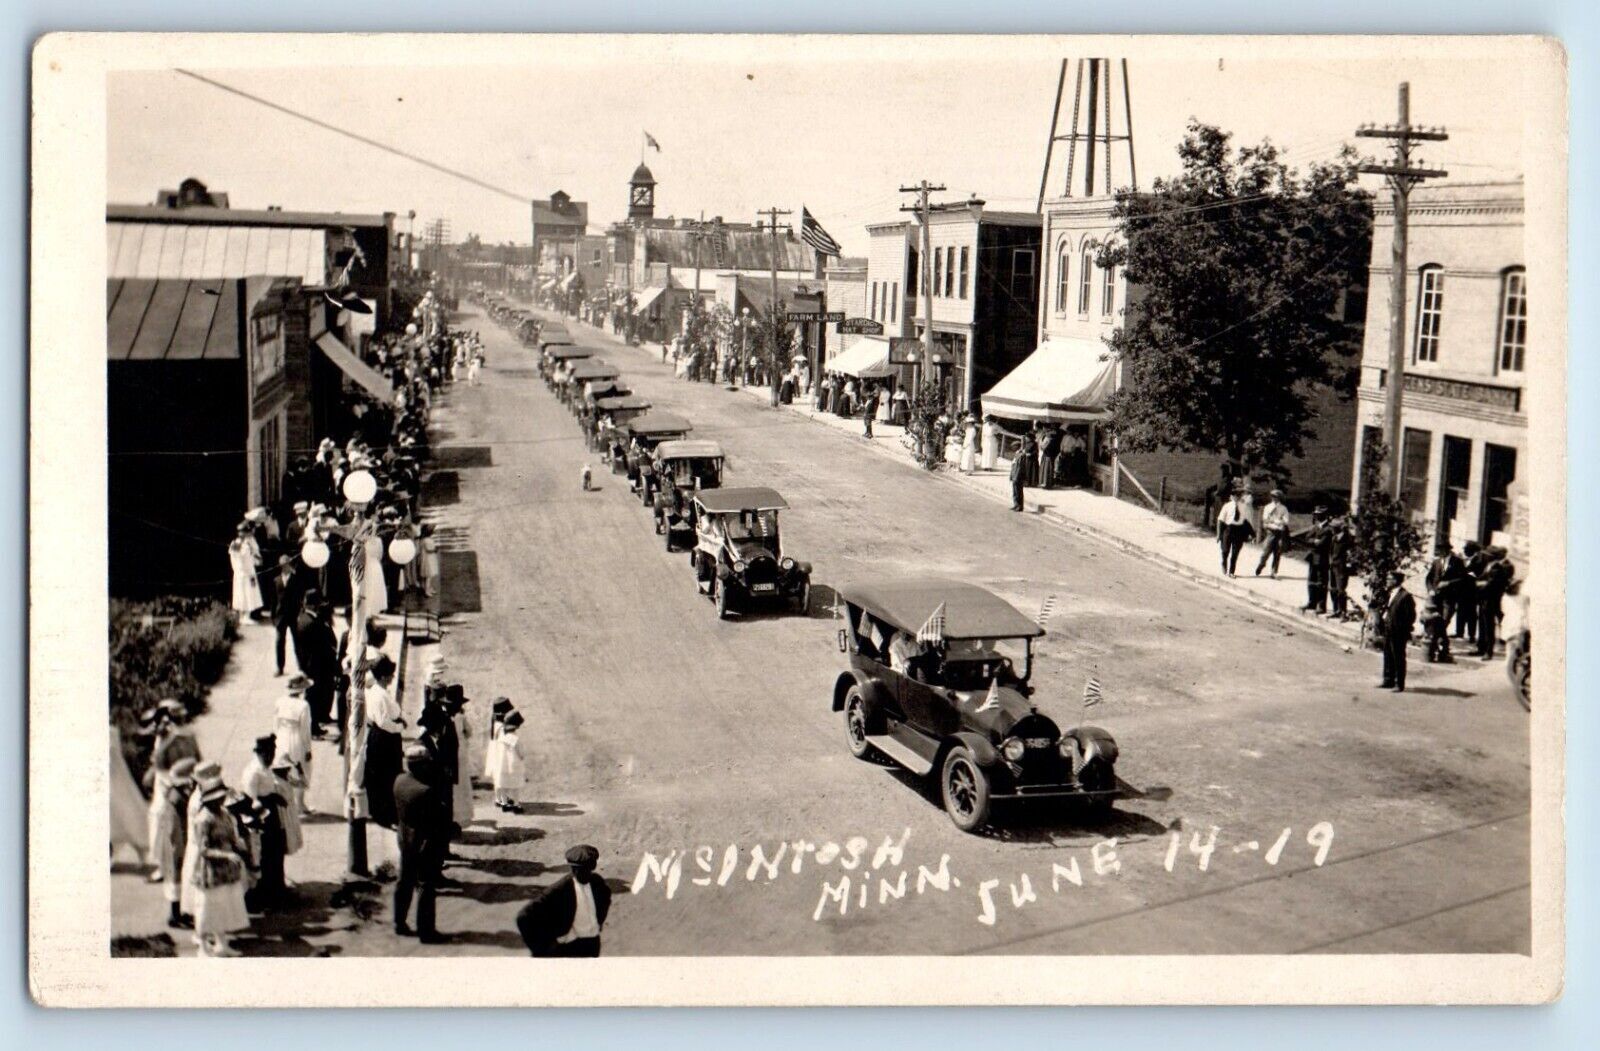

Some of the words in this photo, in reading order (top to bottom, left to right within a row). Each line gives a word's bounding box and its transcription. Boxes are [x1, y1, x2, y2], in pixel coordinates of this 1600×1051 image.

[789, 313, 813, 321] FARM
[816, 313, 842, 321] LAND
[1436, 382, 1470, 399] STATE
